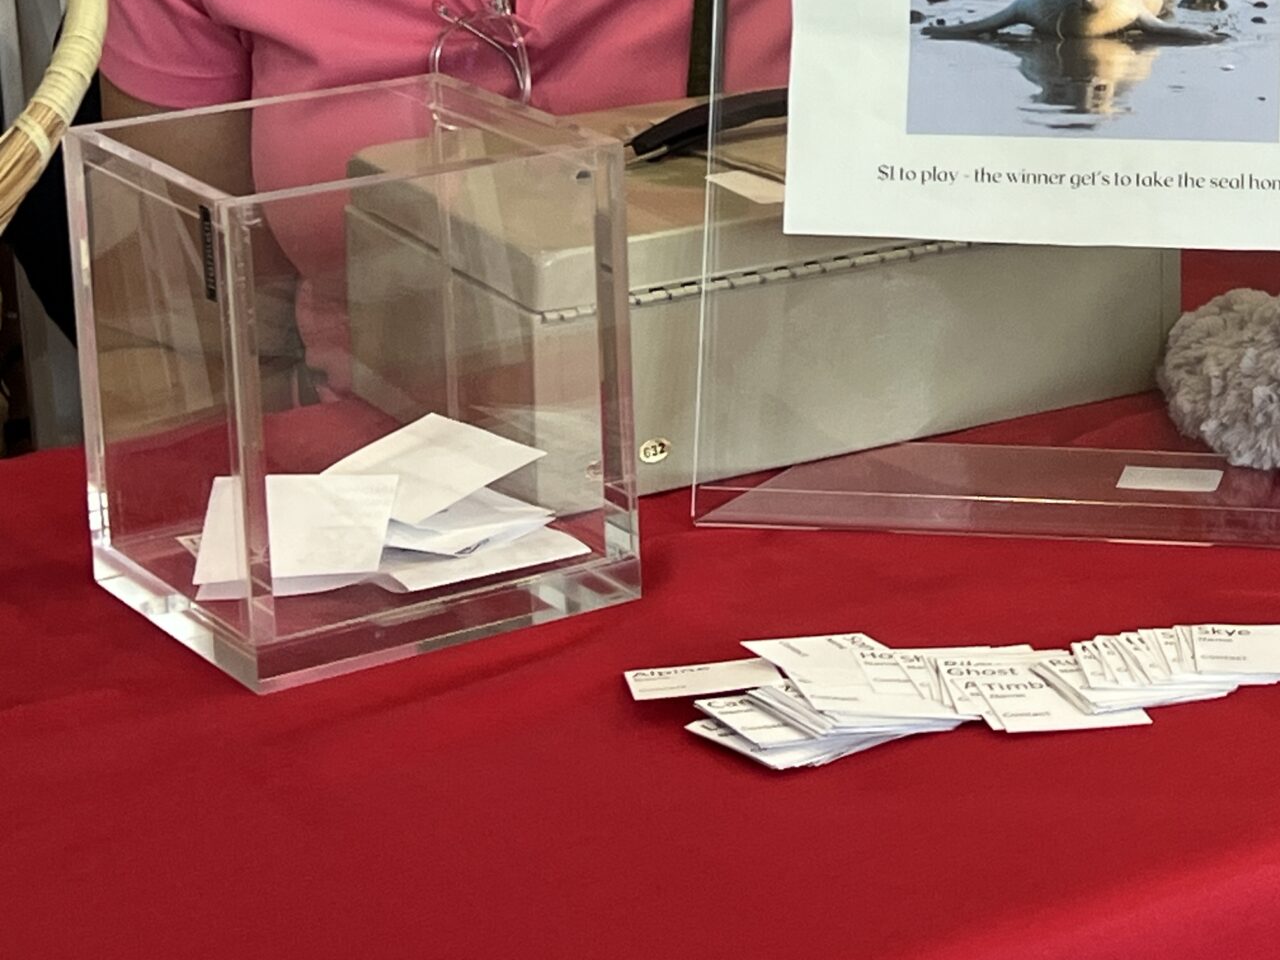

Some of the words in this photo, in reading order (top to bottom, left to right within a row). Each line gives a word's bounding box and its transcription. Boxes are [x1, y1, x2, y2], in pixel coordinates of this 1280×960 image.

[899, 166, 917, 182] to
[920, 165, 959, 186] play
[974, 166, 1002, 184] the
[1006, 168, 1066, 185] winner
[1070, 170, 1111, 190] get's
[1114, 171, 1132, 187] to
[1136, 171, 1174, 189] take
[1178, 171, 1206, 189] the
[1210, 173, 1246, 190] seal
[1197, 626, 1252, 637] Skye
[945, 666, 1020, 677] Ghost
[983, 680, 1051, 691] Timb
